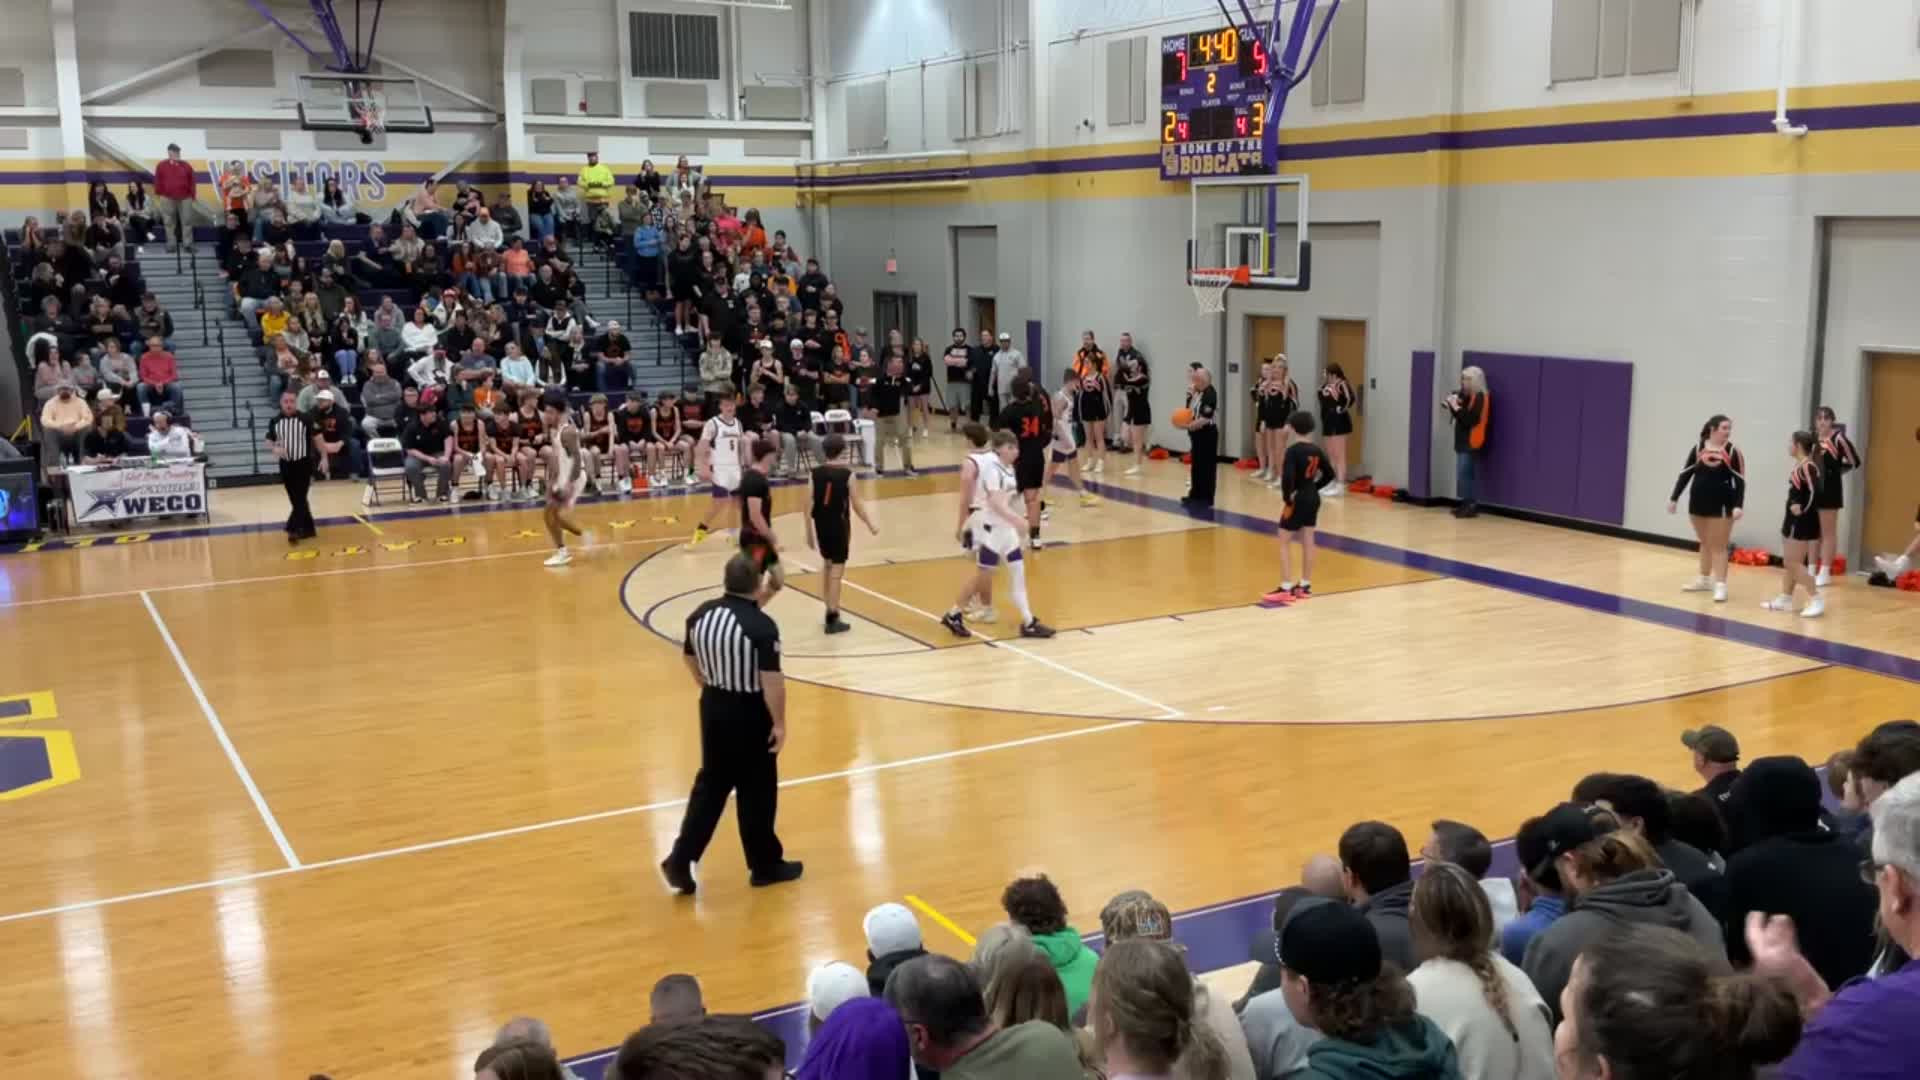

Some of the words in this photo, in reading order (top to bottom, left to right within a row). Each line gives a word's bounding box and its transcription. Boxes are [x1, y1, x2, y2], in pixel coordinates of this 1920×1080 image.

[1163, 38, 1185, 51] HOME
[1200, 28, 1236, 61] 4:40
[1176, 52, 1186, 81] 7
[1253, 40, 1266, 74] 5
[1207, 73, 1216, 93] 2
[1164, 111, 1176, 142] 2
[1236, 117, 1246, 134] 4
[1252, 102, 1264, 135] 3
[1178, 122, 1187, 138] 4
[1181, 142, 1212, 155] HOME
[1218, 141, 1232, 152] OF
[1240, 138, 1262, 150] THE
[1021, 416, 1039, 437] 34
[123, 493, 202, 514] WECO
[825, 482, 832, 505] 1
